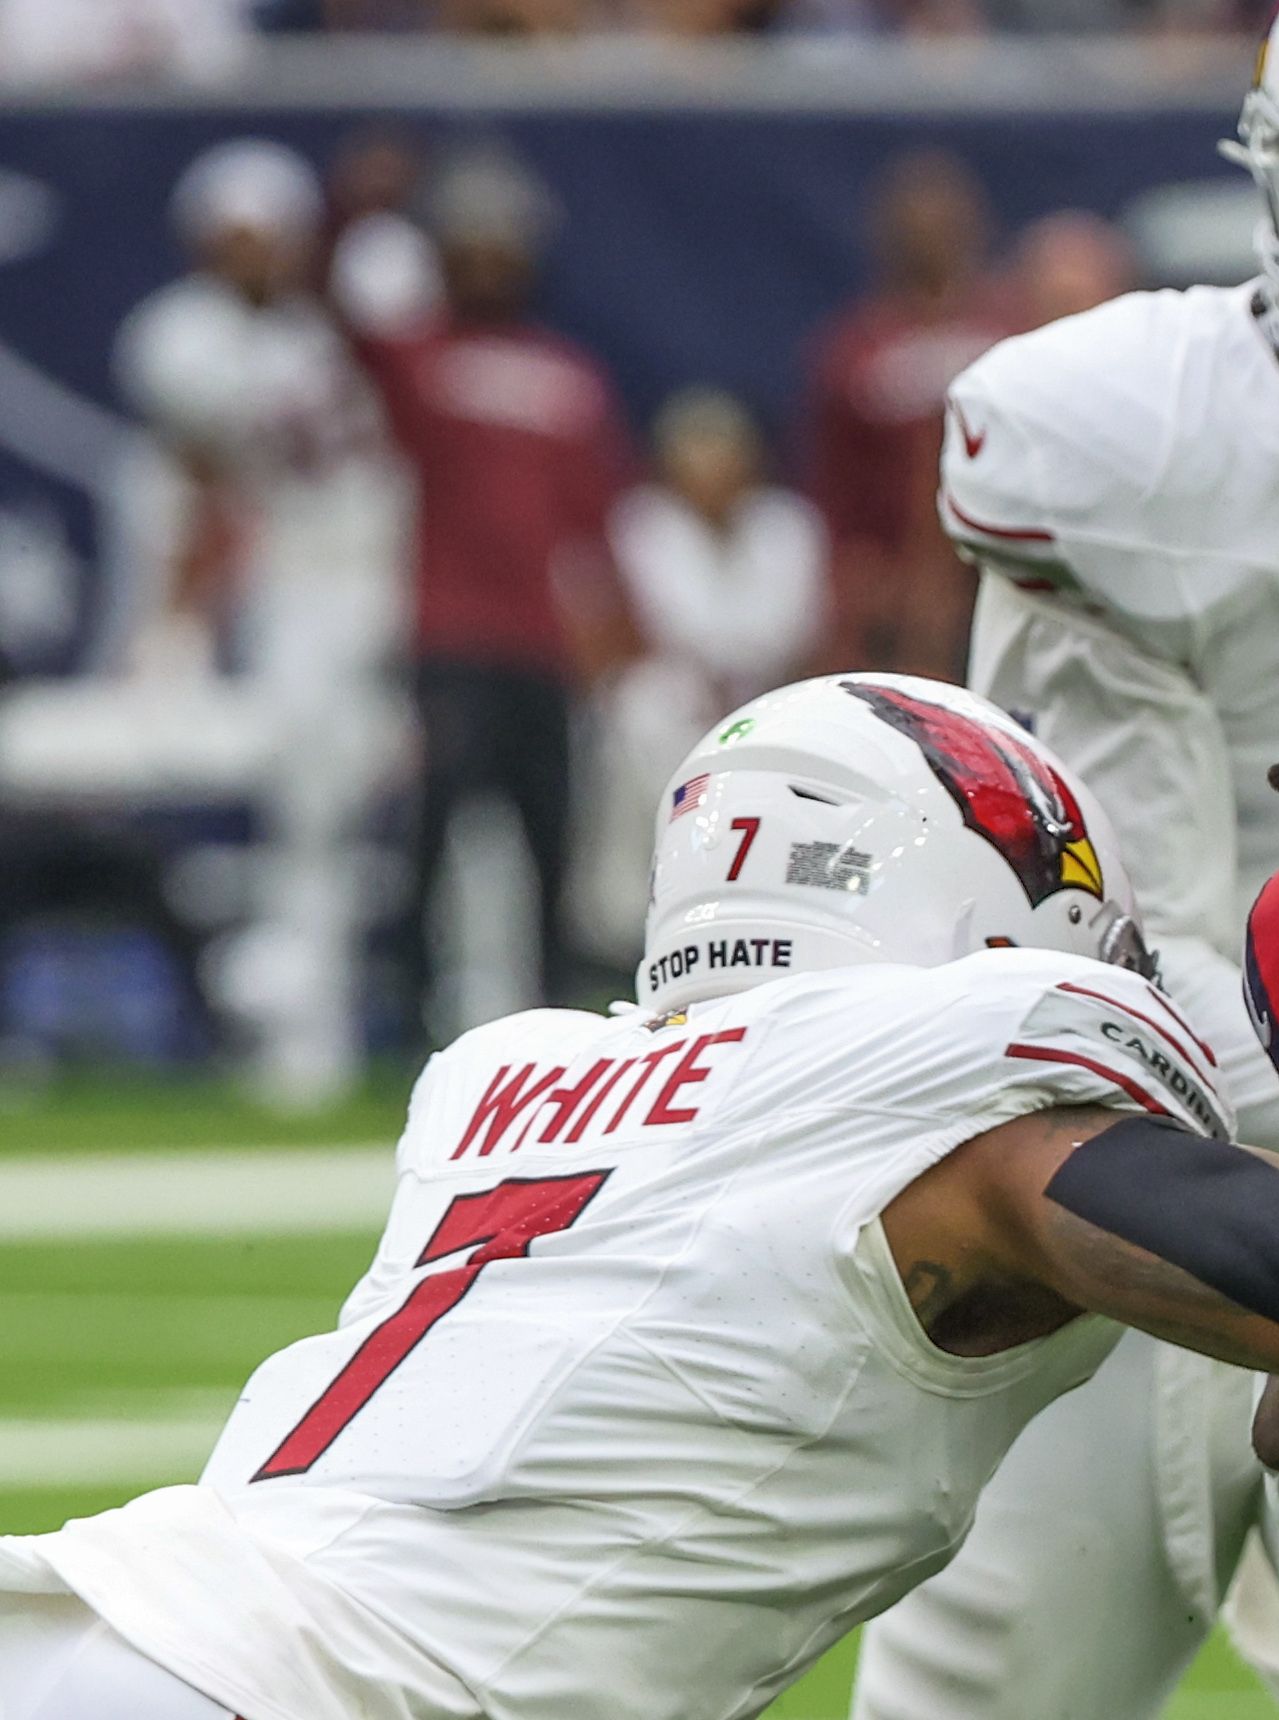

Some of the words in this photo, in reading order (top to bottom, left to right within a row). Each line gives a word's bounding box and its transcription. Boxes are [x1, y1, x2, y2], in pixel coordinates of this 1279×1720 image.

[725, 816, 761, 882] 7
[649, 945, 699, 992] STOP
[708, 938, 792, 969] HATE
[448, 1026, 748, 1161] WHITE
[1101, 1022, 1218, 1139] CARDI
[249, 1167, 617, 1484] 7
